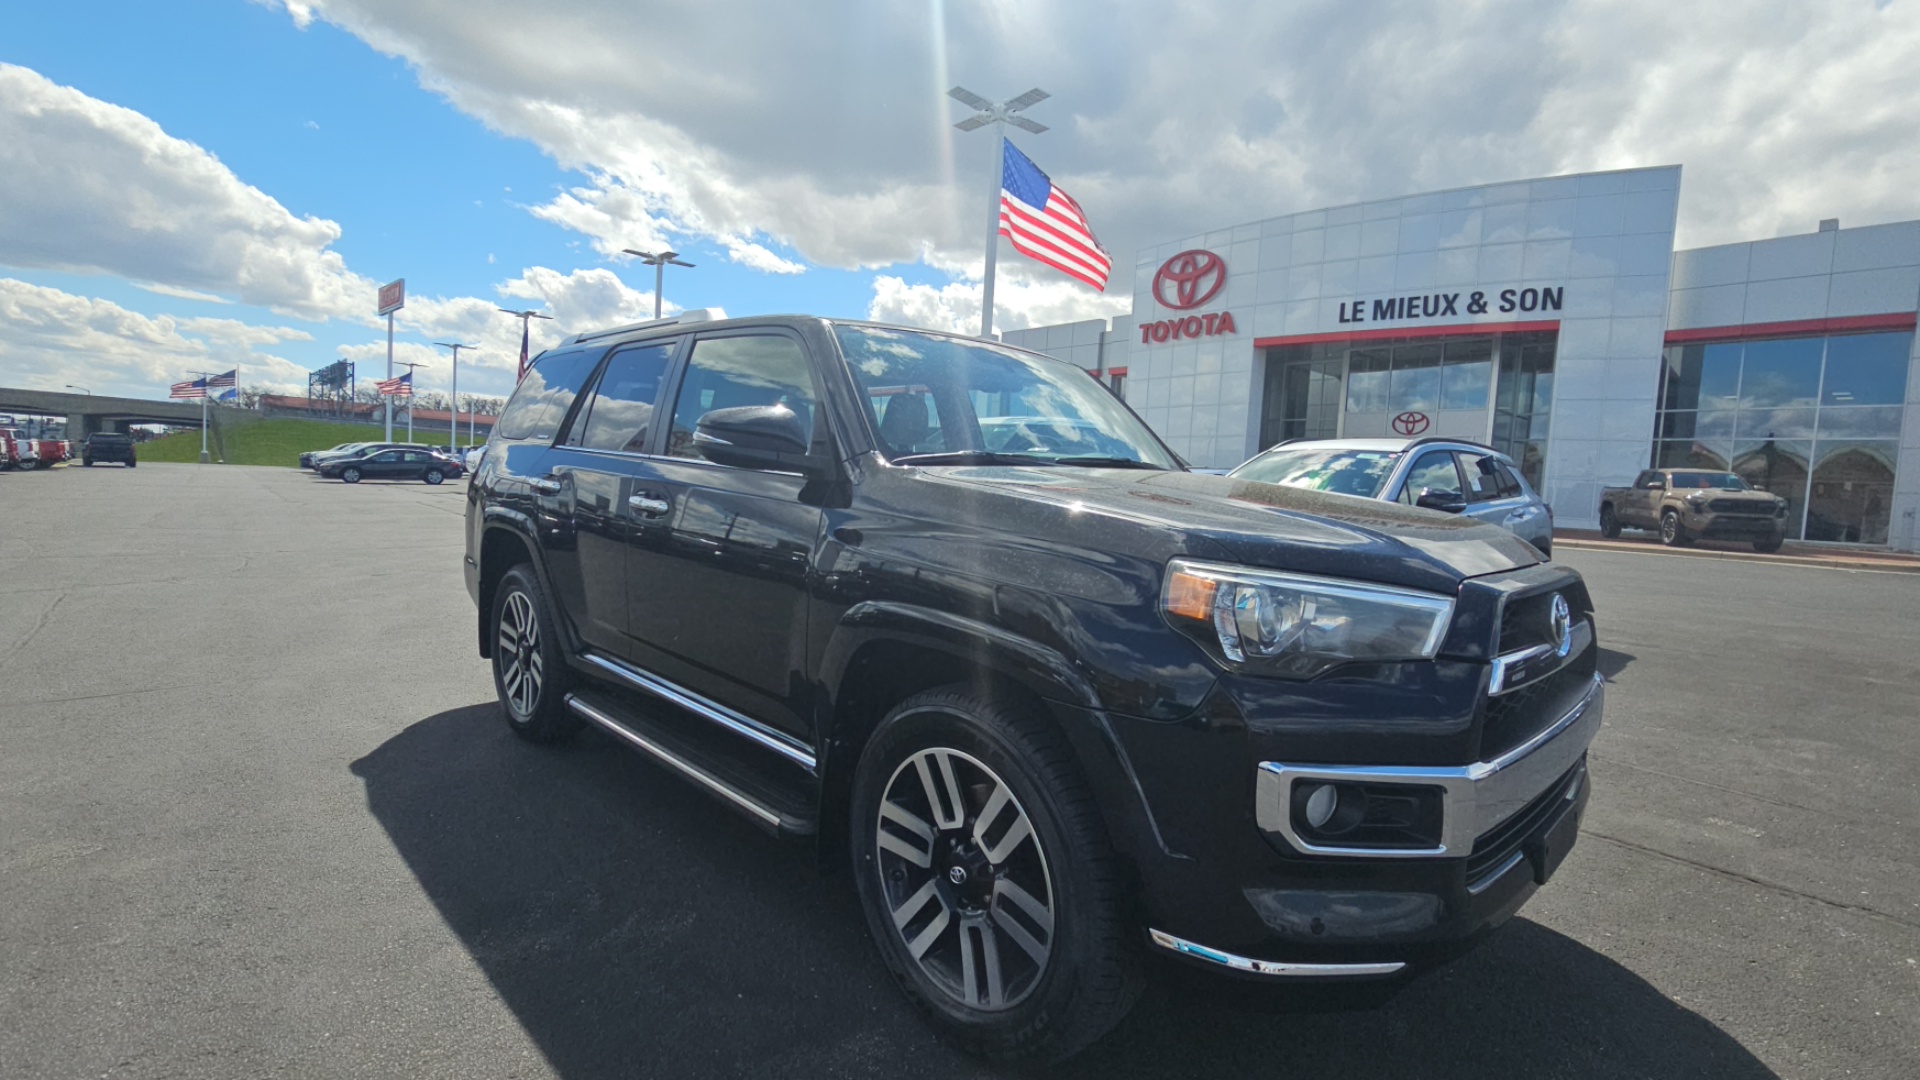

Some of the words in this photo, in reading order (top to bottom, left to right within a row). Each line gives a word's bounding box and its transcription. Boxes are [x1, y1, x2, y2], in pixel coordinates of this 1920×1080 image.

[1339, 301, 1365, 323] LE
[1372, 293, 1460, 321] MIEUX
[1467, 291, 1488, 314] &
[1499, 287, 1564, 313] SON
[1139, 311, 1236, 344] TOYOTA
